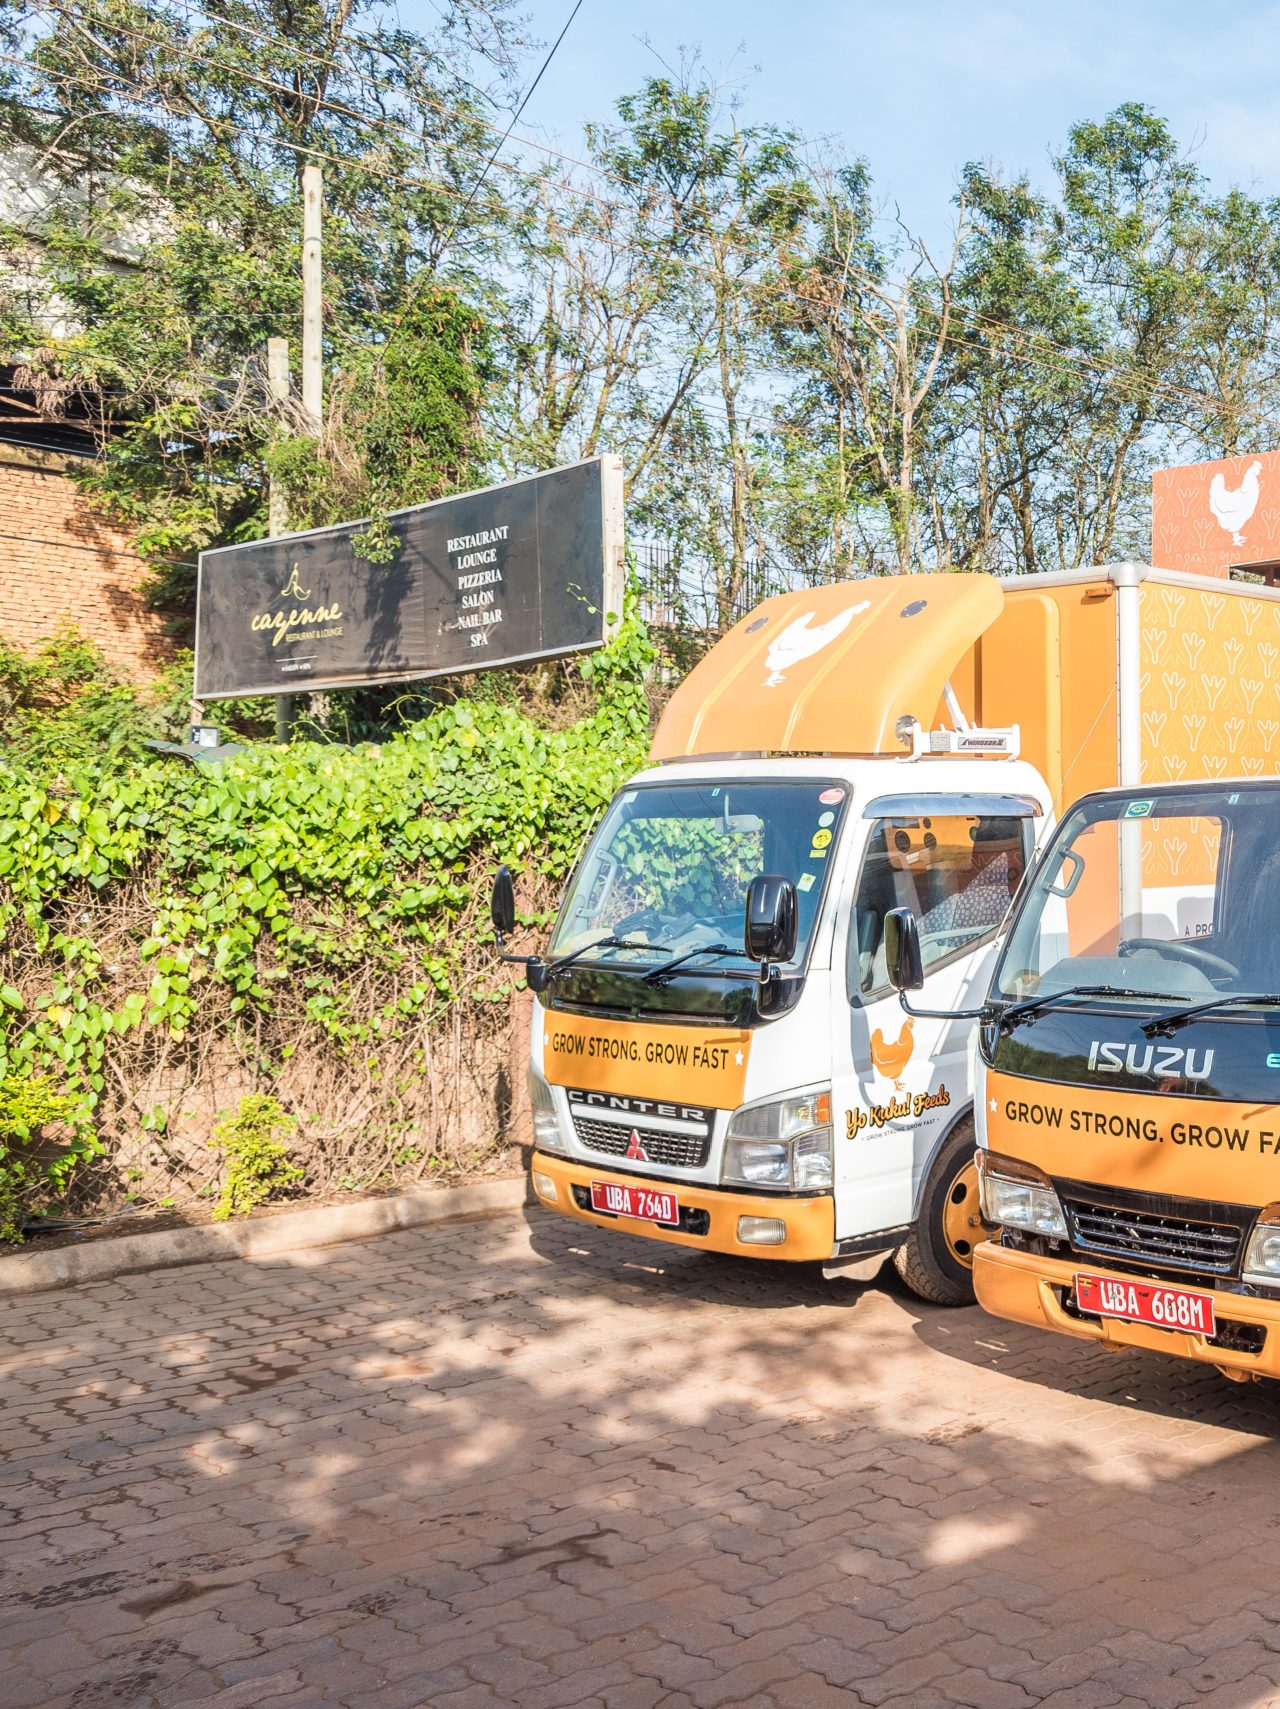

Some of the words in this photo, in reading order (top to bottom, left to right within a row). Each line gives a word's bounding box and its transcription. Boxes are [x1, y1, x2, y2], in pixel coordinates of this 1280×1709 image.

[447, 526, 508, 552] RESTAURANT
[457, 549, 497, 569] LOUNGE
[458, 569, 502, 589] PIZZERIA
[462, 590, 494, 608] SALON
[458, 613, 480, 629] NAIL
[482, 609, 502, 625] BAR
[321, 626, 343, 638] LOUNGE
[470, 634, 488, 647] SPA
[552, 1033, 586, 1055] GROW
[589, 1037, 641, 1061] STRONG.
[645, 1042, 688, 1066] GROW
[693, 1047, 729, 1070] FAST
[1087, 1041, 1214, 1080] ISUZU
[845, 1107, 867, 1140] Yo
[869, 1092, 912, 1128] Kuku!
[913, 1083, 951, 1117] Feeds
[866, 1133, 883, 1141] GROW
[907, 1121, 922, 1131] GROW
[924, 1118, 935, 1126] FAST
[1005, 1100, 1063, 1128] GROW
[1070, 1110, 1164, 1143] STRONG.
[1170, 1122, 1249, 1151] GROW
[606, 1186, 631, 1212] UBA
[1100, 1281, 1139, 1315] UBA
